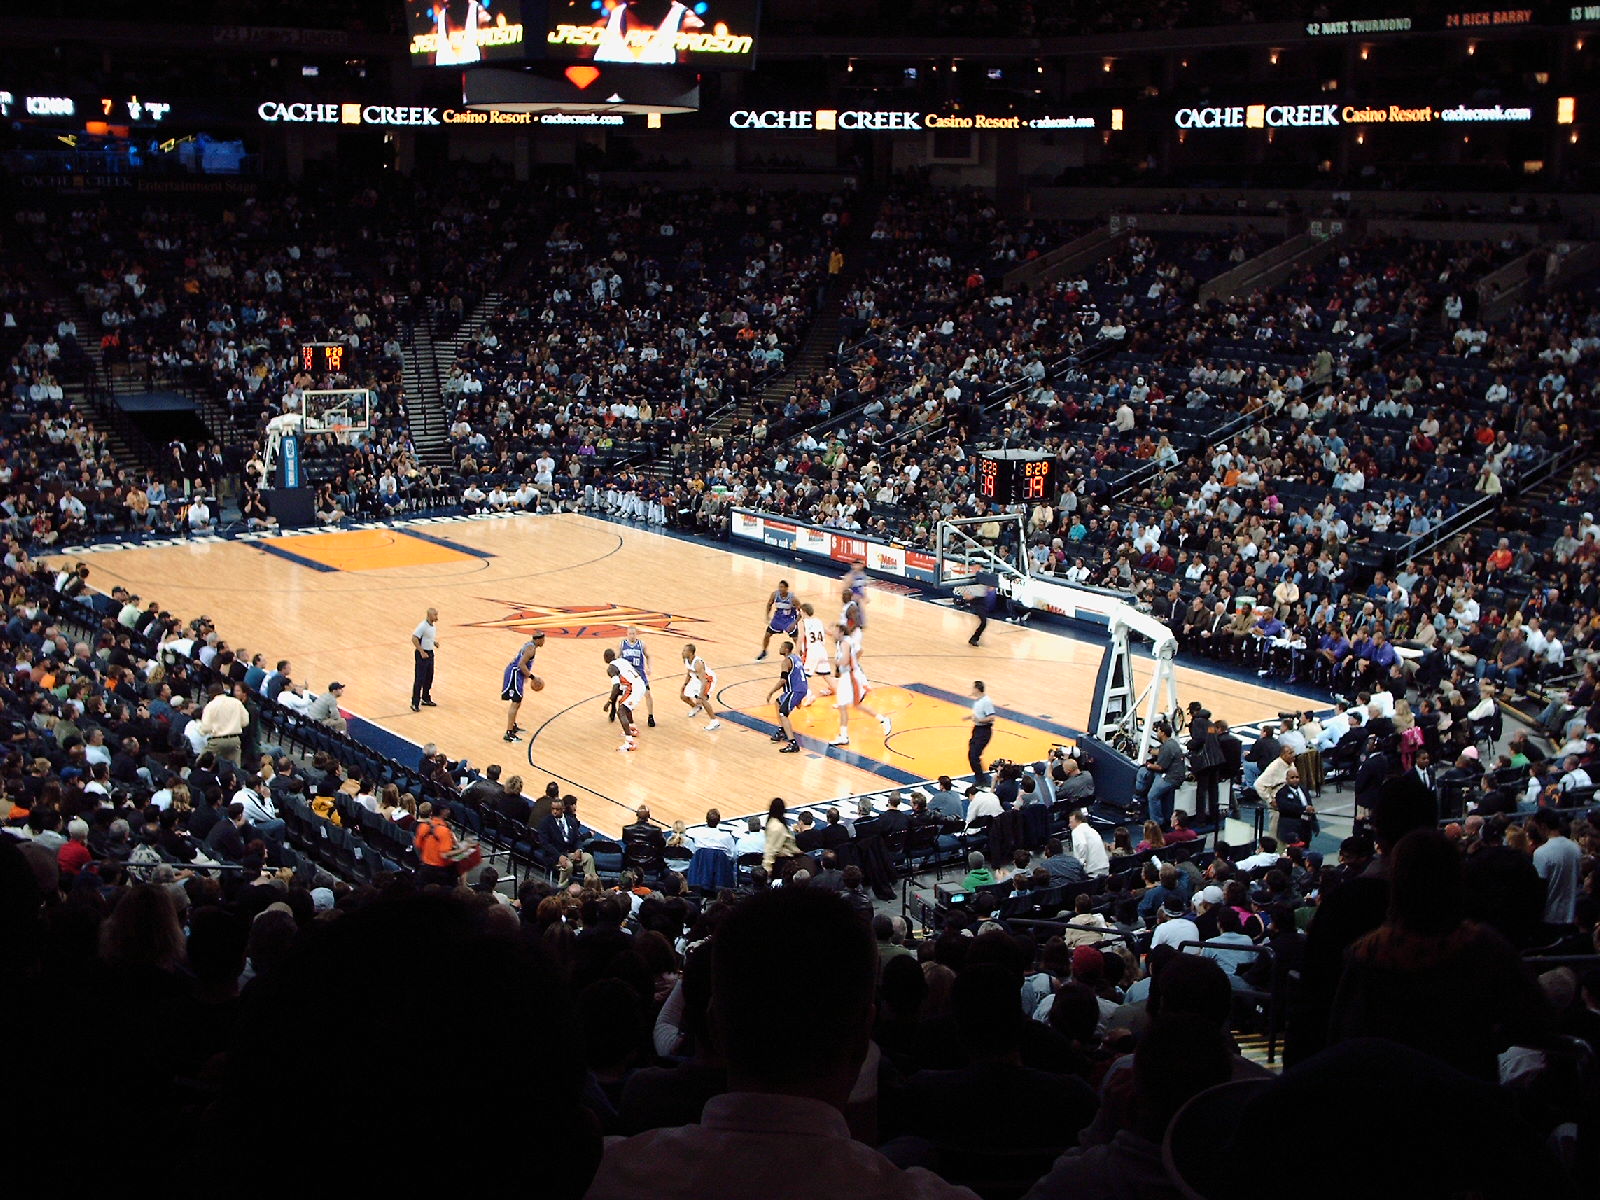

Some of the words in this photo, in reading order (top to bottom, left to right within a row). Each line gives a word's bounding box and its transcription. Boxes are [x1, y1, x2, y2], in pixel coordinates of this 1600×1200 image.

[1350, 18, 1412, 32] THURMOND
[1462, 12, 1490, 26] RICK
[1492, 10, 1533, 24] BARRY
[257, 102, 339, 123] CACHE
[362, 106, 441, 125] CREEK
[442, 109, 487, 123] Casino
[489, 109, 531, 124] Resort
[729, 110, 813, 129] CACHE
[838, 111, 923, 130] CREEK
[924, 114, 972, 128] Casino
[974, 115, 1020, 128] Resort
[1174, 107, 1245, 129] CACHE
[1265, 104, 1340, 127] CREEK
[1342, 106, 1387, 123] Casino
[1388, 105, 1432, 122] Resort
[1025, 461, 1049, 476] 8:28
[810, 631, 823, 643] 34
